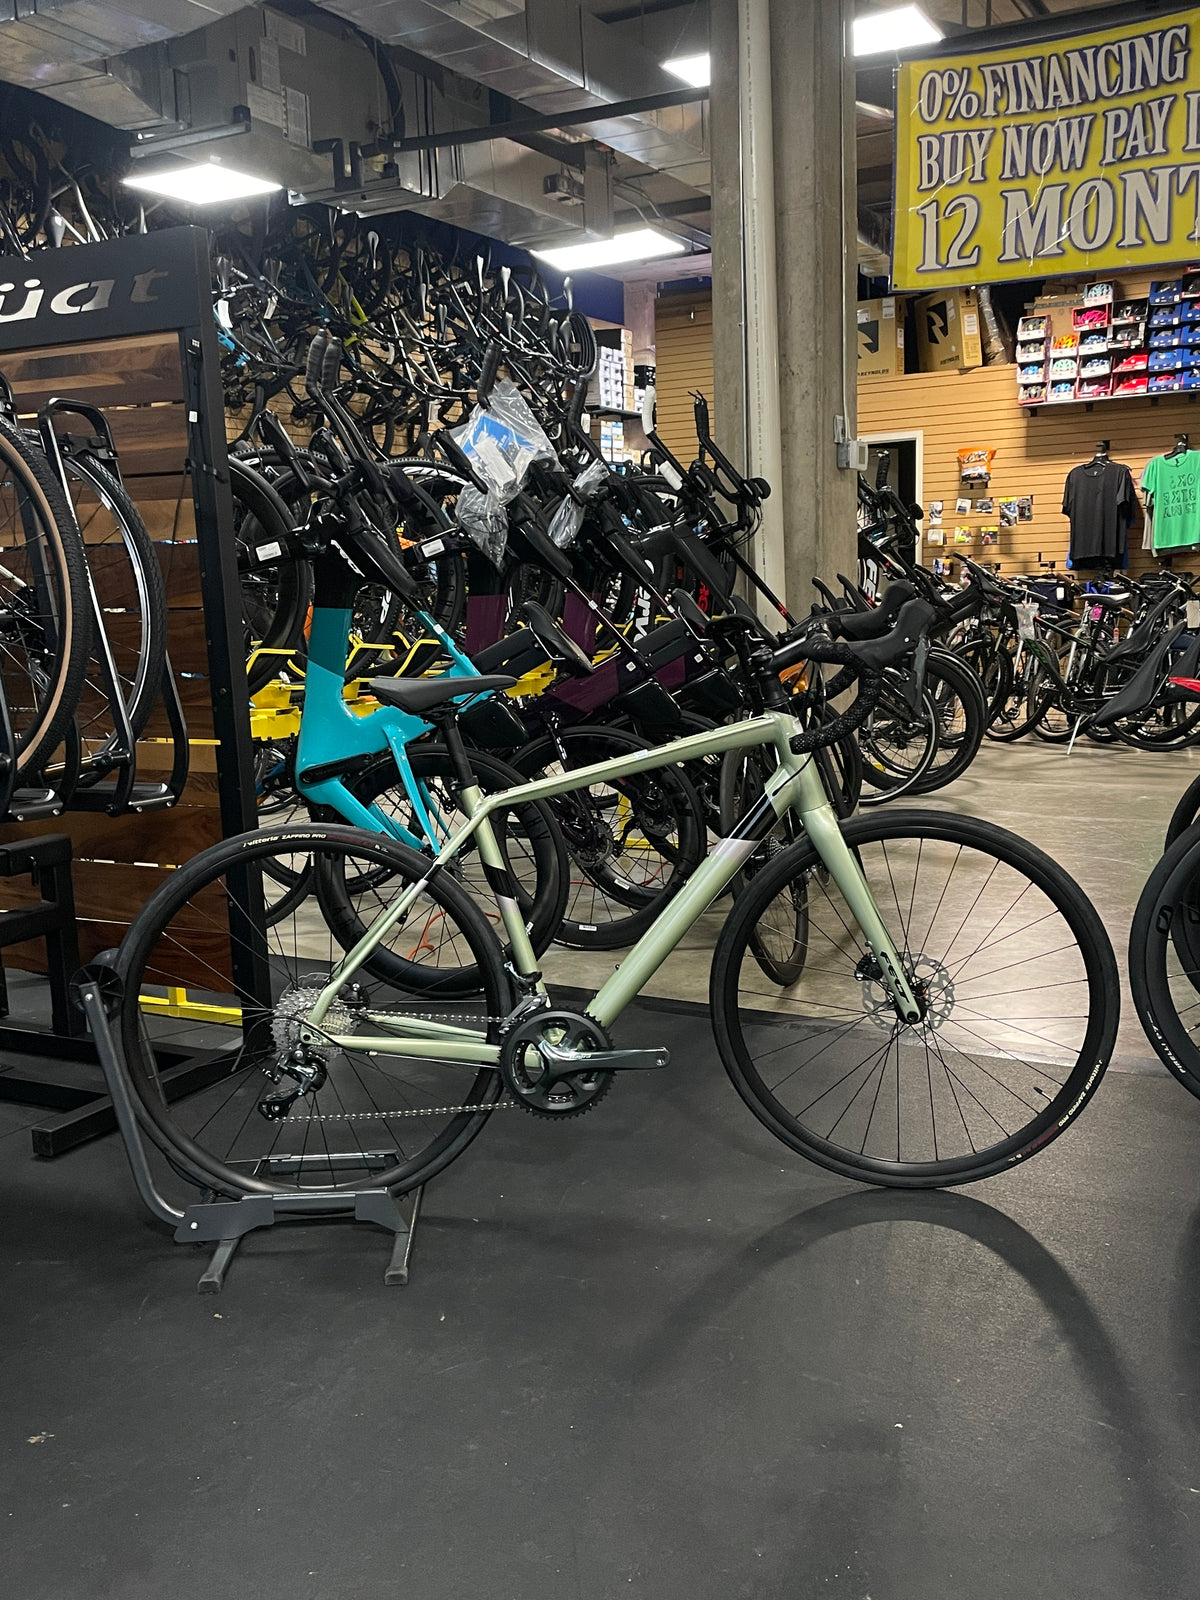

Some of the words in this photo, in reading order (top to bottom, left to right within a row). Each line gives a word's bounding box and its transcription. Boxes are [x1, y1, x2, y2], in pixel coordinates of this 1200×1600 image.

[917, 129, 994, 191] BUY
[1000, 114, 1096, 180] NOW
[1100, 95, 1177, 166] PAY
[917, 195, 979, 272] 12
[1161, 1043, 1186, 1073] PIRELLI
